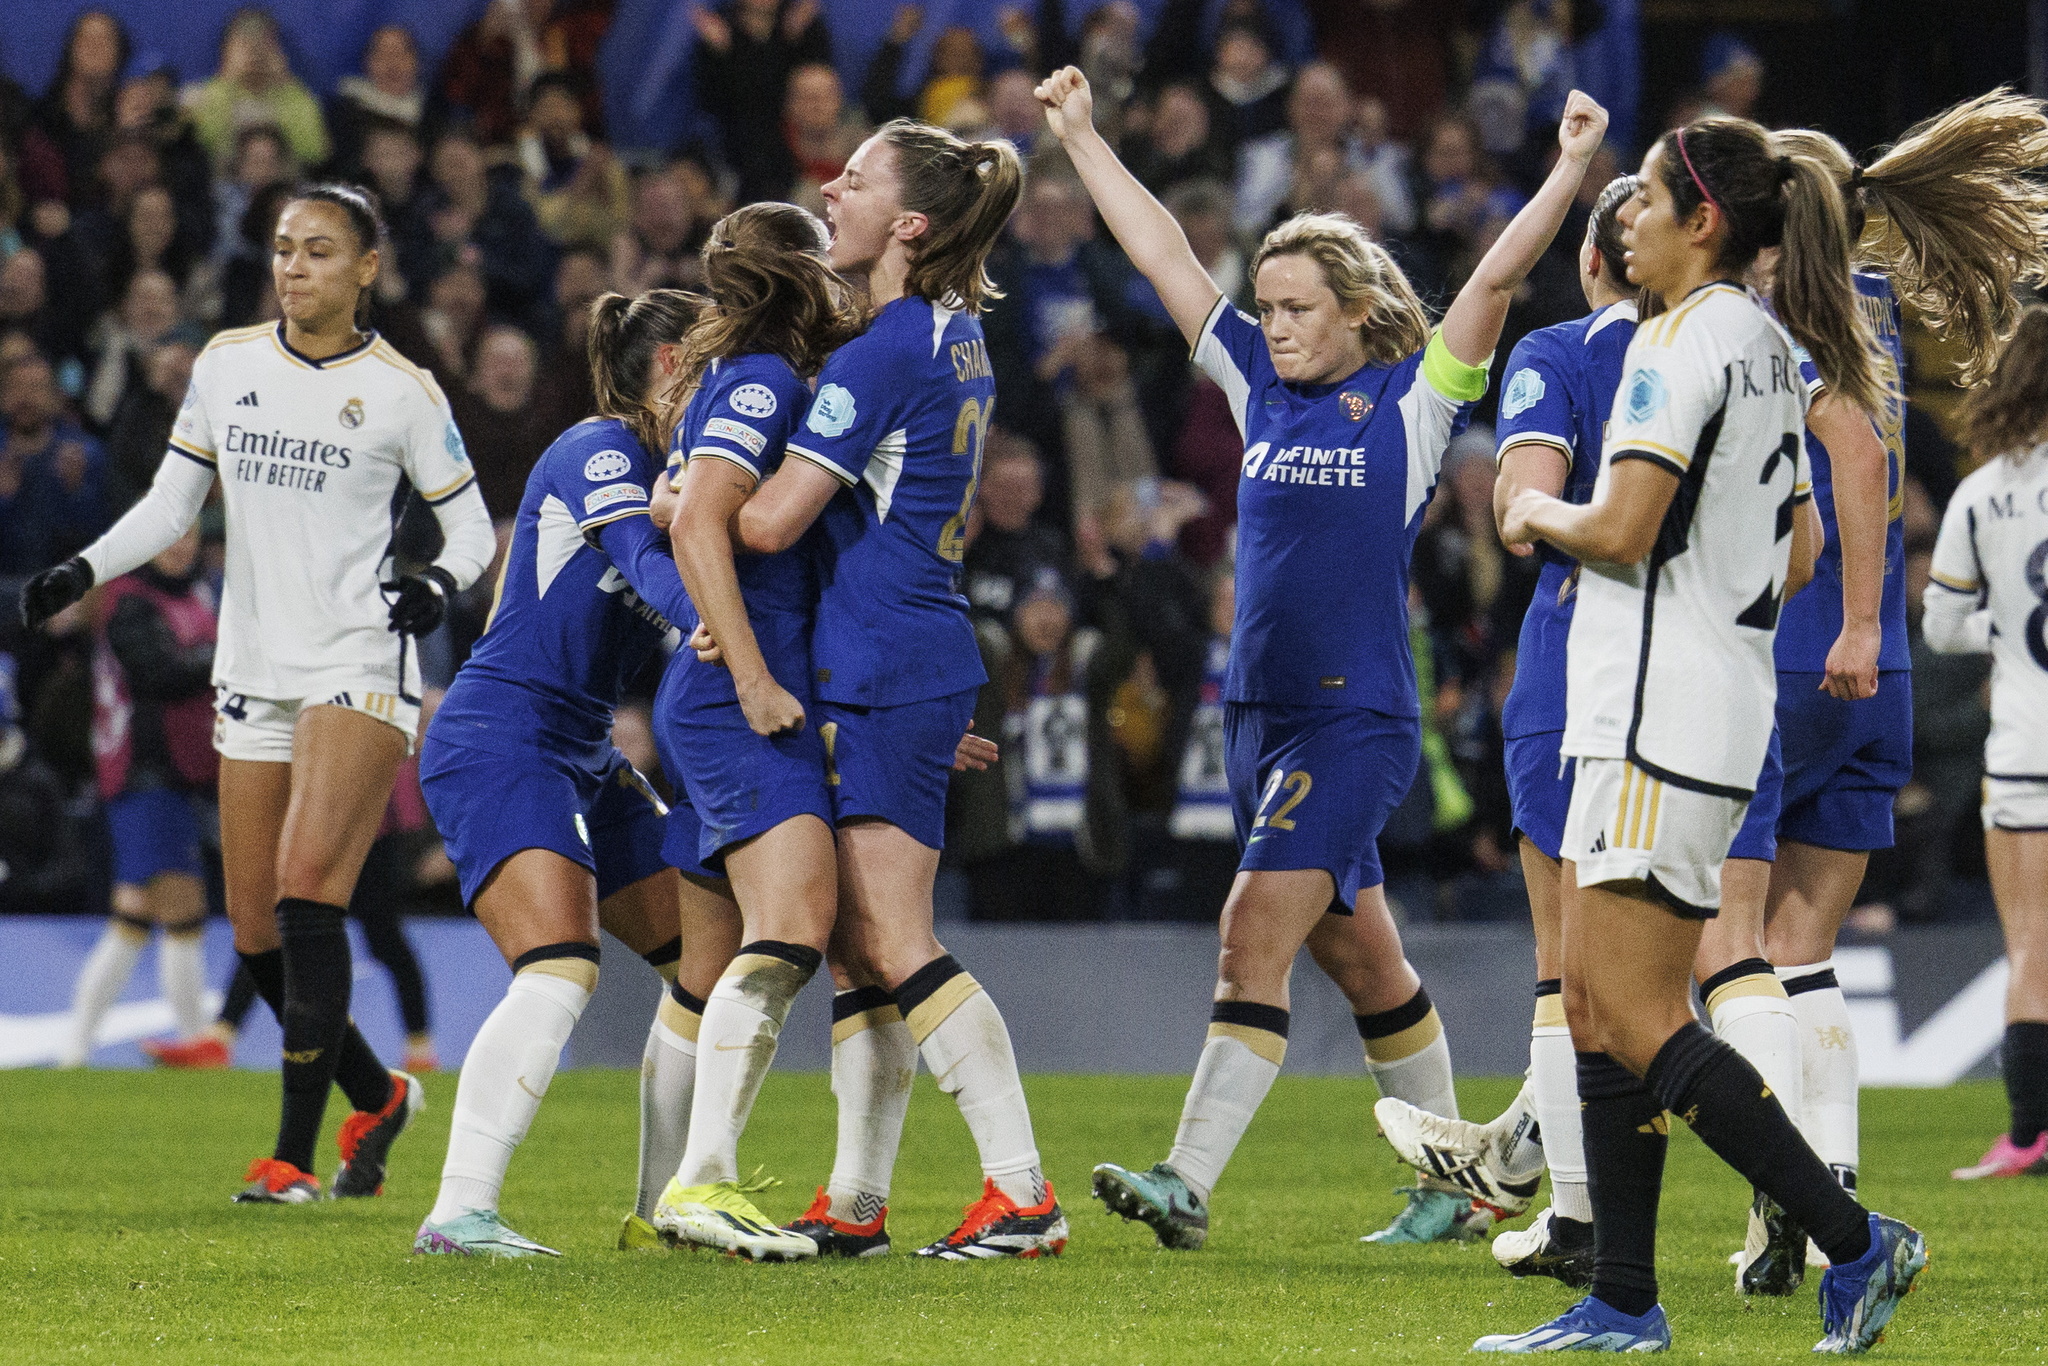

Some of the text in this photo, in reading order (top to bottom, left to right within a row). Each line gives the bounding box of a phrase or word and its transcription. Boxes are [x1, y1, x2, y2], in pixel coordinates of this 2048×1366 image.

[1738, 360, 1764, 398] K.
[226, 424, 352, 469] Emirates
[708, 423, 767, 451] FOUNDATION
[237, 459, 327, 492] FLY BETTER
[1262, 463, 1366, 487] ATHLETE
[1252, 768, 1313, 832] 22
